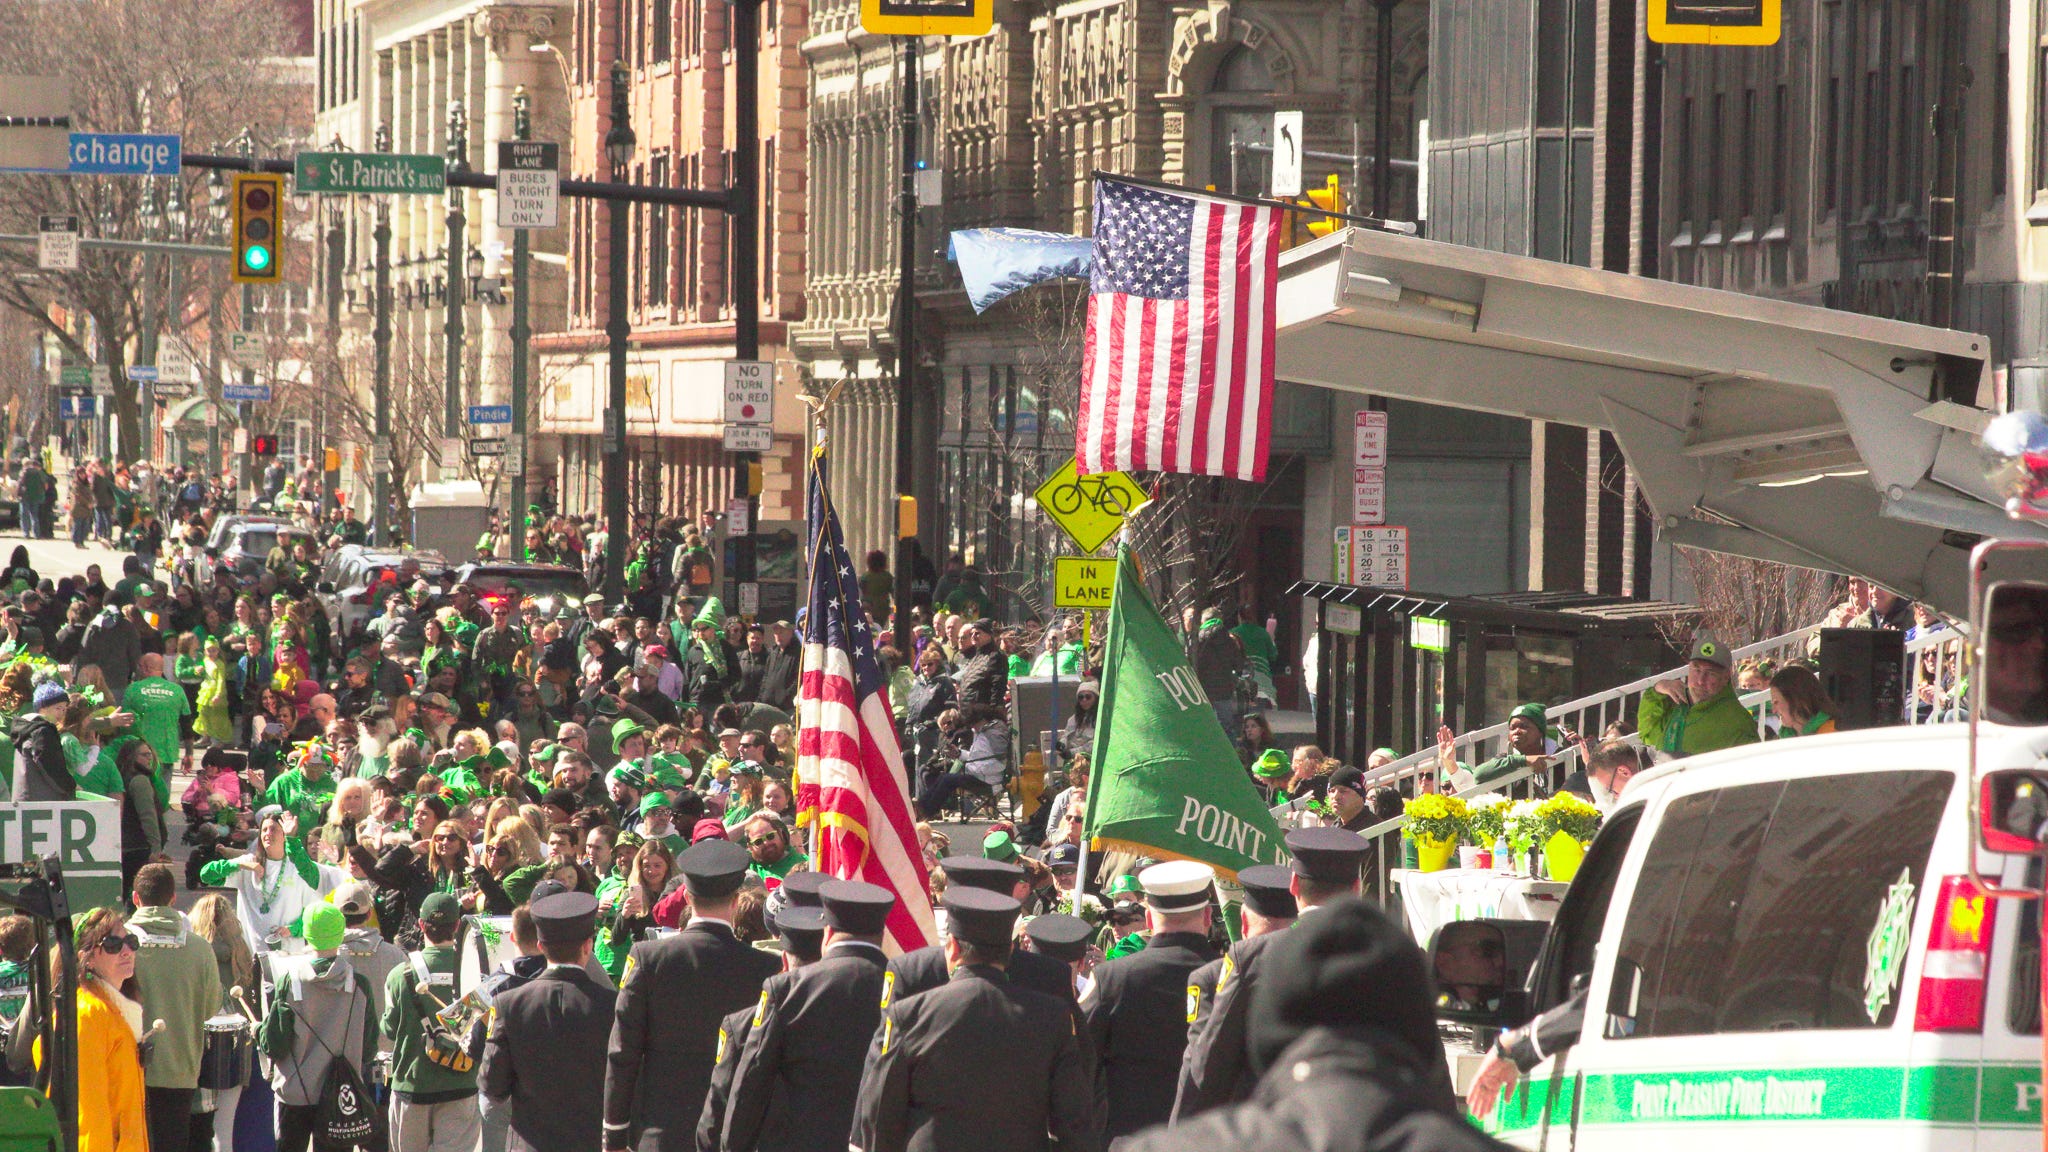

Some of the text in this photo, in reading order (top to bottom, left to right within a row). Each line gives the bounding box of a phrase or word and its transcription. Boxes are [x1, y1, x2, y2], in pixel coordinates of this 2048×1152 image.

[69, 138, 169, 173] change
[513, 145, 543, 156] RIGHT
[514, 157, 542, 167] LANE
[329, 158, 442, 188] St. Patrick's BLVD
[510, 173, 546, 183] BUSES
[1276, 172, 1297, 187] ONLY
[505, 186, 551, 197] & RIGHT
[513, 199, 543, 210] TURN
[511, 212, 543, 223] ONLY
[738, 365, 760, 377] NO
[735, 379, 763, 389] TURN
[728, 392, 769, 403] ON RED
[473, 409, 507, 420] Pindle
[1357, 414, 1366, 425] NO
[1364, 431, 1377, 439] ANY
[1364, 441, 1377, 449] TIME
[1356, 470, 1364, 481] NO
[1358, 487, 1380, 495] EXCEPT
[1359, 498, 1379, 506] BUSES
[1362, 530, 1373, 538] 16
[1387, 530, 1399, 538] 17
[1361, 544, 1373, 552] 18
[1387, 544, 1399, 552] 19
[1361, 558, 1373, 567] 20
[1386, 558, 1398, 567] 21
[1080, 567, 1097, 580] IN
[1361, 573, 1373, 581] 22
[1387, 573, 1399, 581] 23
[1065, 587, 1111, 600] LANE
[1175, 795, 1267, 863] POINT
[1764, 1075, 1827, 1115] DISTRICT
